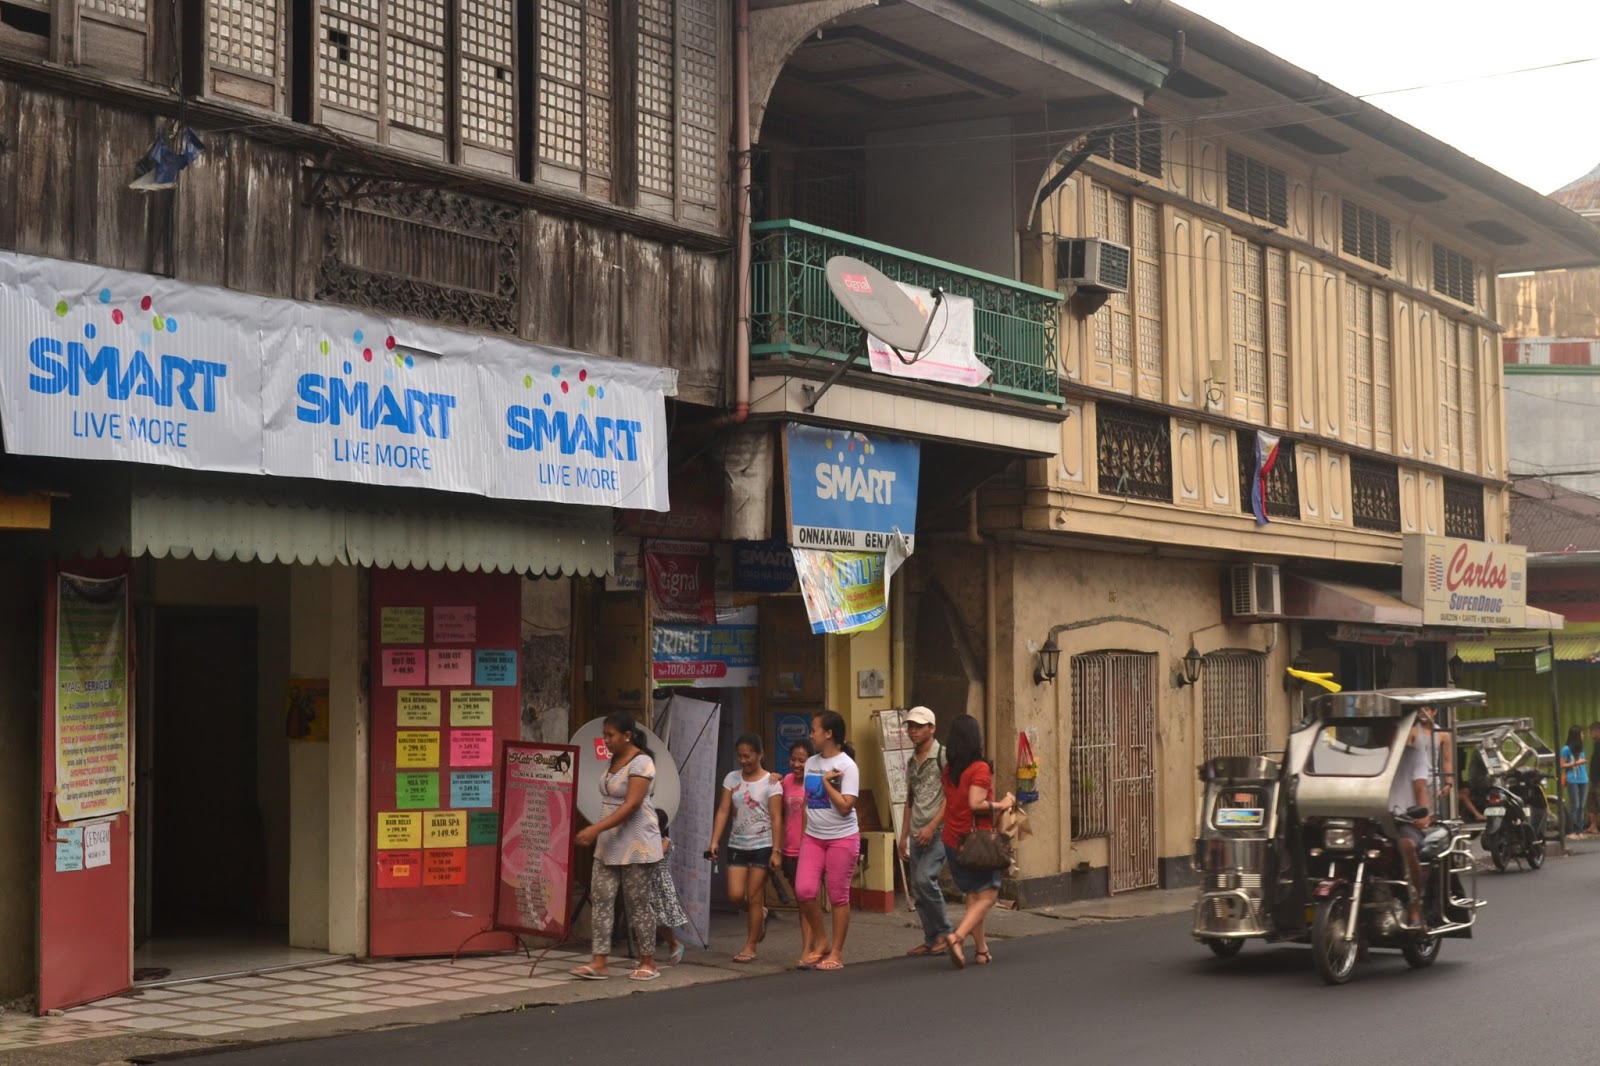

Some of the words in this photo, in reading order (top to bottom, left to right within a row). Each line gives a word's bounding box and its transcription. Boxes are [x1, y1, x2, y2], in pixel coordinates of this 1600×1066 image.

[29, 336, 227, 413] SMART
[296, 372, 456, 440] SMART
[73, 410, 122, 439] LIVE
[130, 416, 188, 448] MORE
[506, 404, 642, 462] SMART
[333, 438, 370, 465] LIVE
[375, 443, 432, 470] MORE
[539, 463, 570, 487] LIVE
[576, 467, 619, 491] MORE
[815, 462, 896, 505] SMART
[799, 527, 855, 547] ONNAKAWAI
[1446, 543, 1507, 592] Carlos
[667, 664, 696, 676] TOTAL20
[701, 664, 718, 675] 2477
[431, 819, 447, 827] HAIR
[448, 819, 461, 827] SPA
[437, 828, 459, 837] 149.95
